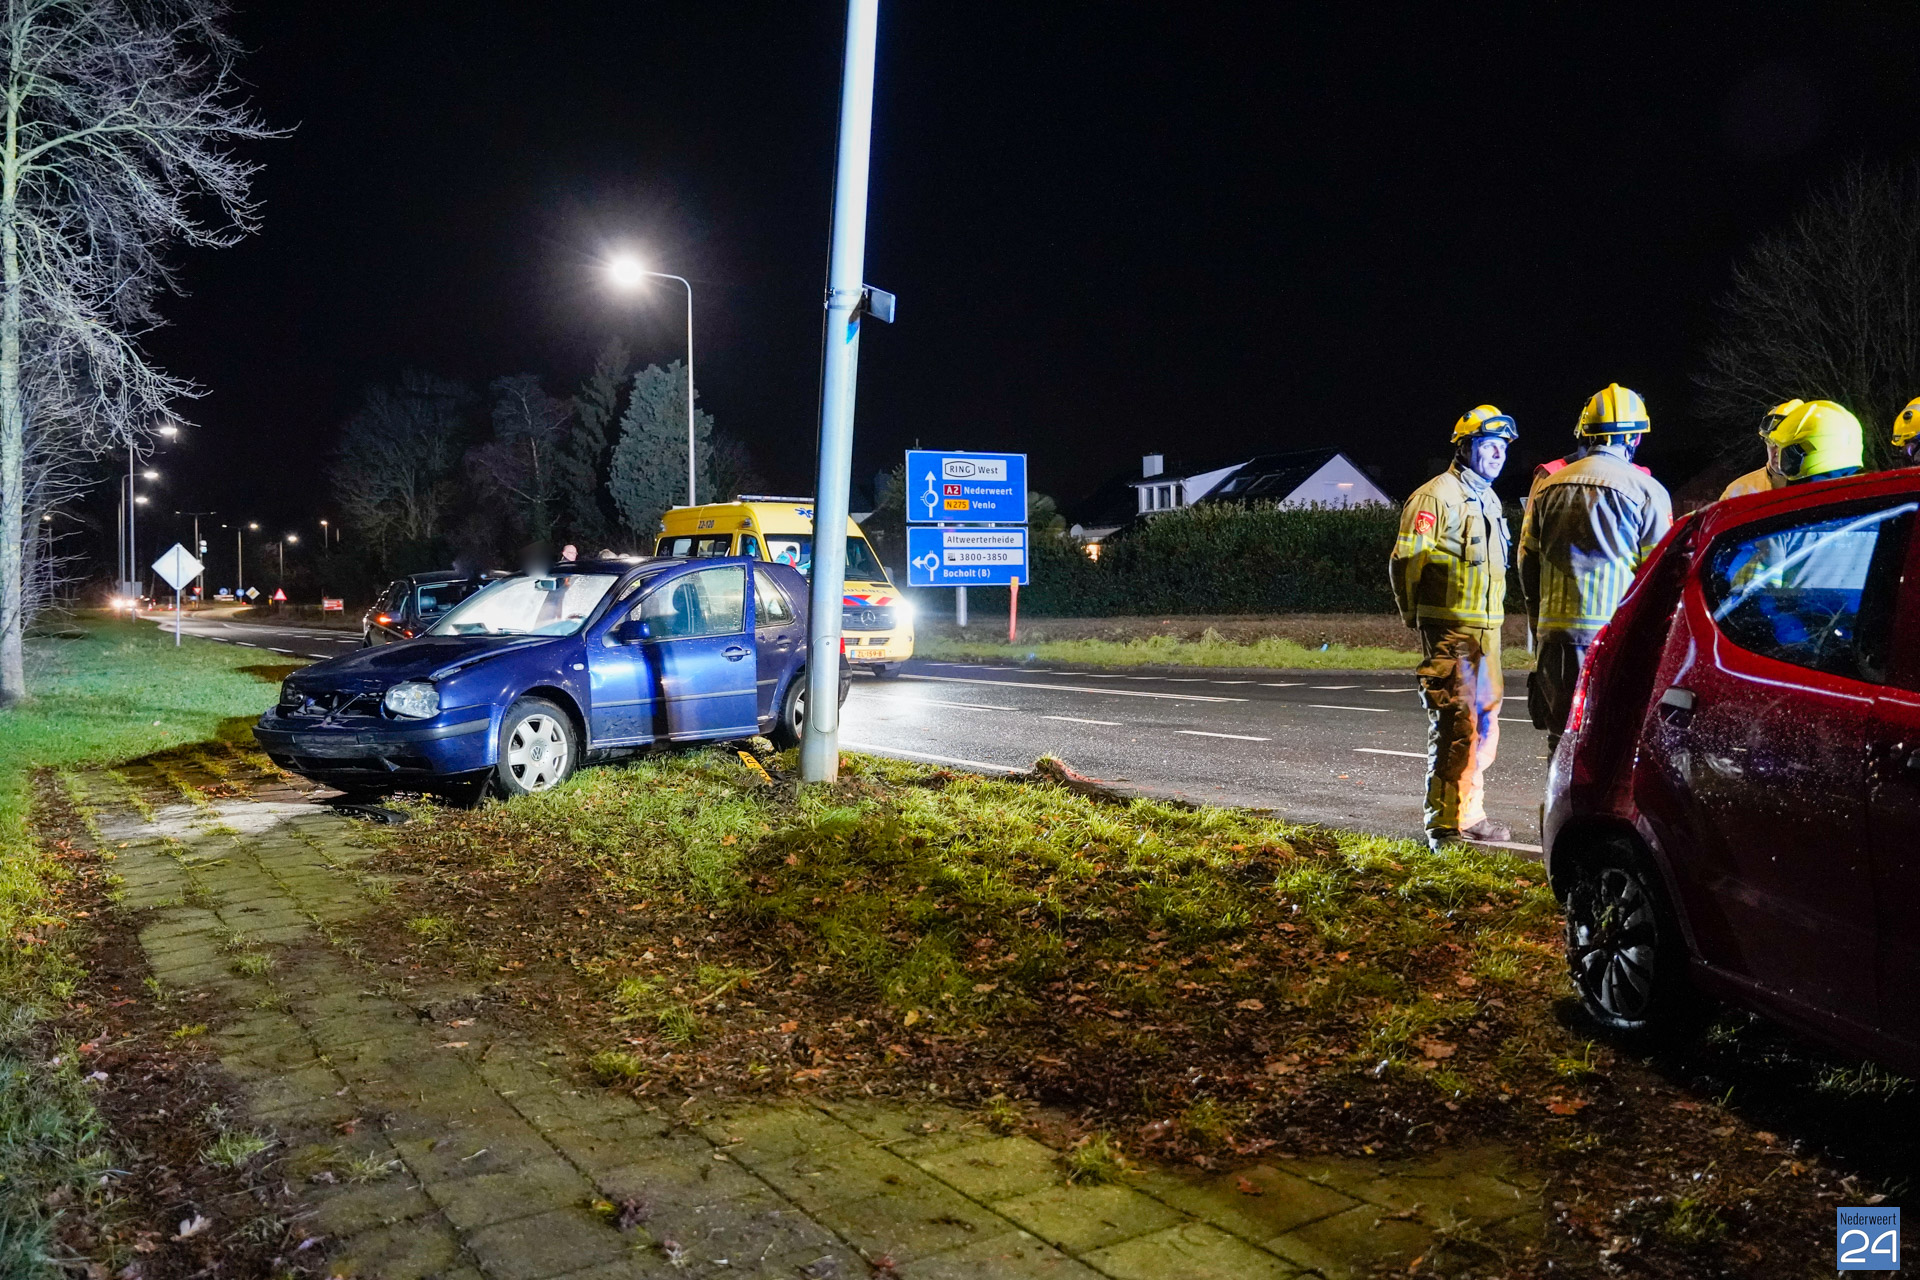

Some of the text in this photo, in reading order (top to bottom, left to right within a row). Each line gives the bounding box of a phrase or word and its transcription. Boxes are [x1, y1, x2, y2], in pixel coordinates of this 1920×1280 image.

[949, 465, 998, 475] RING West
[946, 486, 1013, 495] A2 Nederweert
[972, 501, 996, 509] Venlo
[946, 535, 1015, 544] Altweerterheide
[960, 553, 1007, 561] 3800-3850
[943, 568, 991, 578] Bocholt (B)
